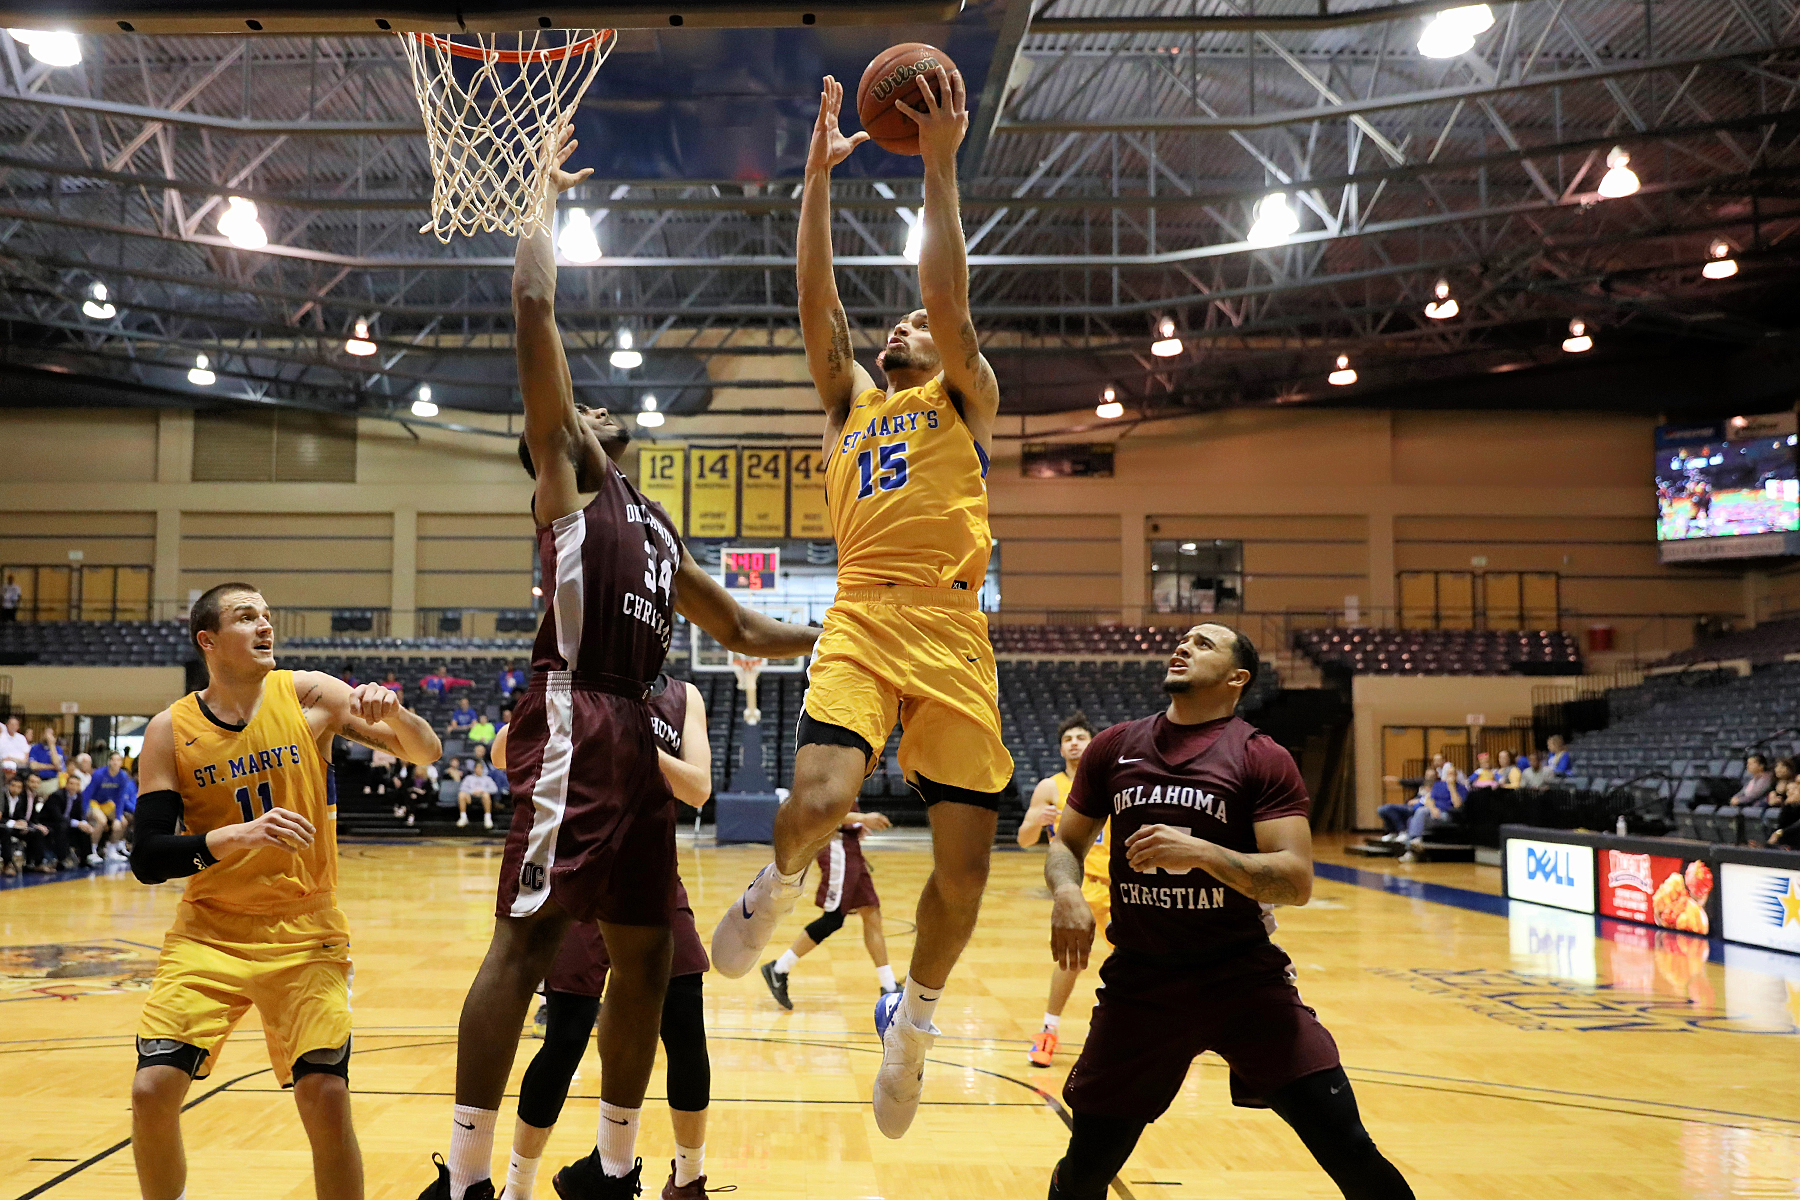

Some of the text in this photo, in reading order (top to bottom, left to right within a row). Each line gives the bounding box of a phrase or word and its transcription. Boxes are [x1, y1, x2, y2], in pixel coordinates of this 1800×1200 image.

[871, 57, 940, 102] Wilson
[862, 409, 939, 441] MARY'S
[650, 454, 674, 480] 12
[697, 454, 729, 480] 14
[747, 454, 780, 480] 24
[794, 454, 827, 480] 44
[856, 440, 909, 500] 15
[644, 540, 673, 606] 34
[952, 582, 963, 590] XL
[194, 744, 300, 788] ST. MARY'S
[234, 780, 274, 823] 11
[1113, 784, 1228, 824] OKLAHOMA
[1527, 847, 1575, 887] DELL
[1119, 882, 1225, 910] CHRISTIAN
